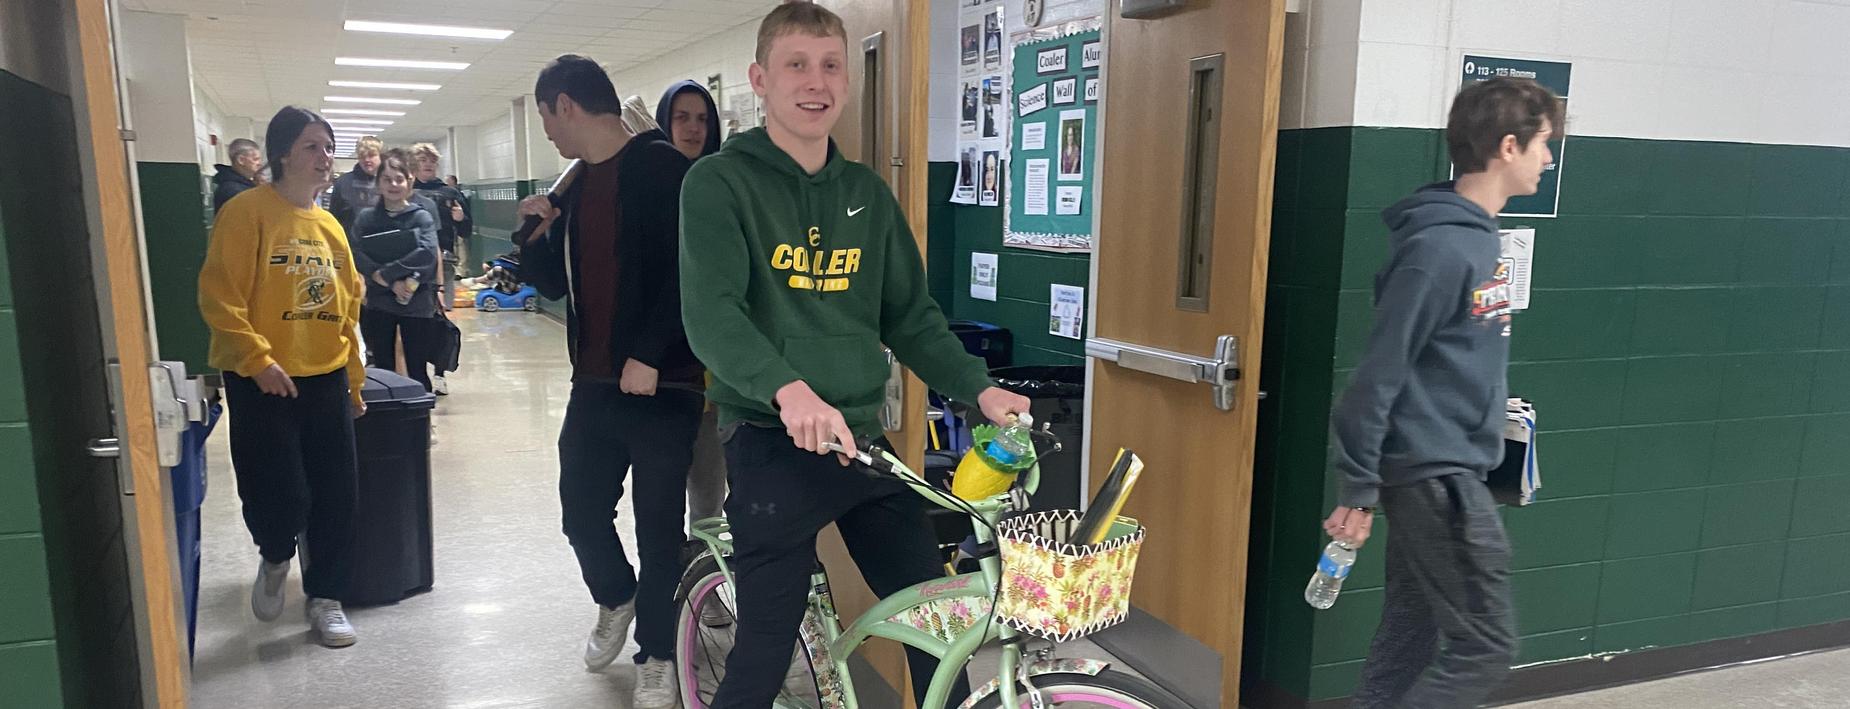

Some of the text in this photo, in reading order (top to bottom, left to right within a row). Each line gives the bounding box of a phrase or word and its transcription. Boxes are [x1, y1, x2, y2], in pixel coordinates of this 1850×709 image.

[1040, 53, 1064, 68] Coaler
[1477, 66, 1490, 76] 113
[1509, 68, 1537, 79] Rooms
[1056, 83, 1073, 97] Wall
[1087, 82, 1098, 97] of
